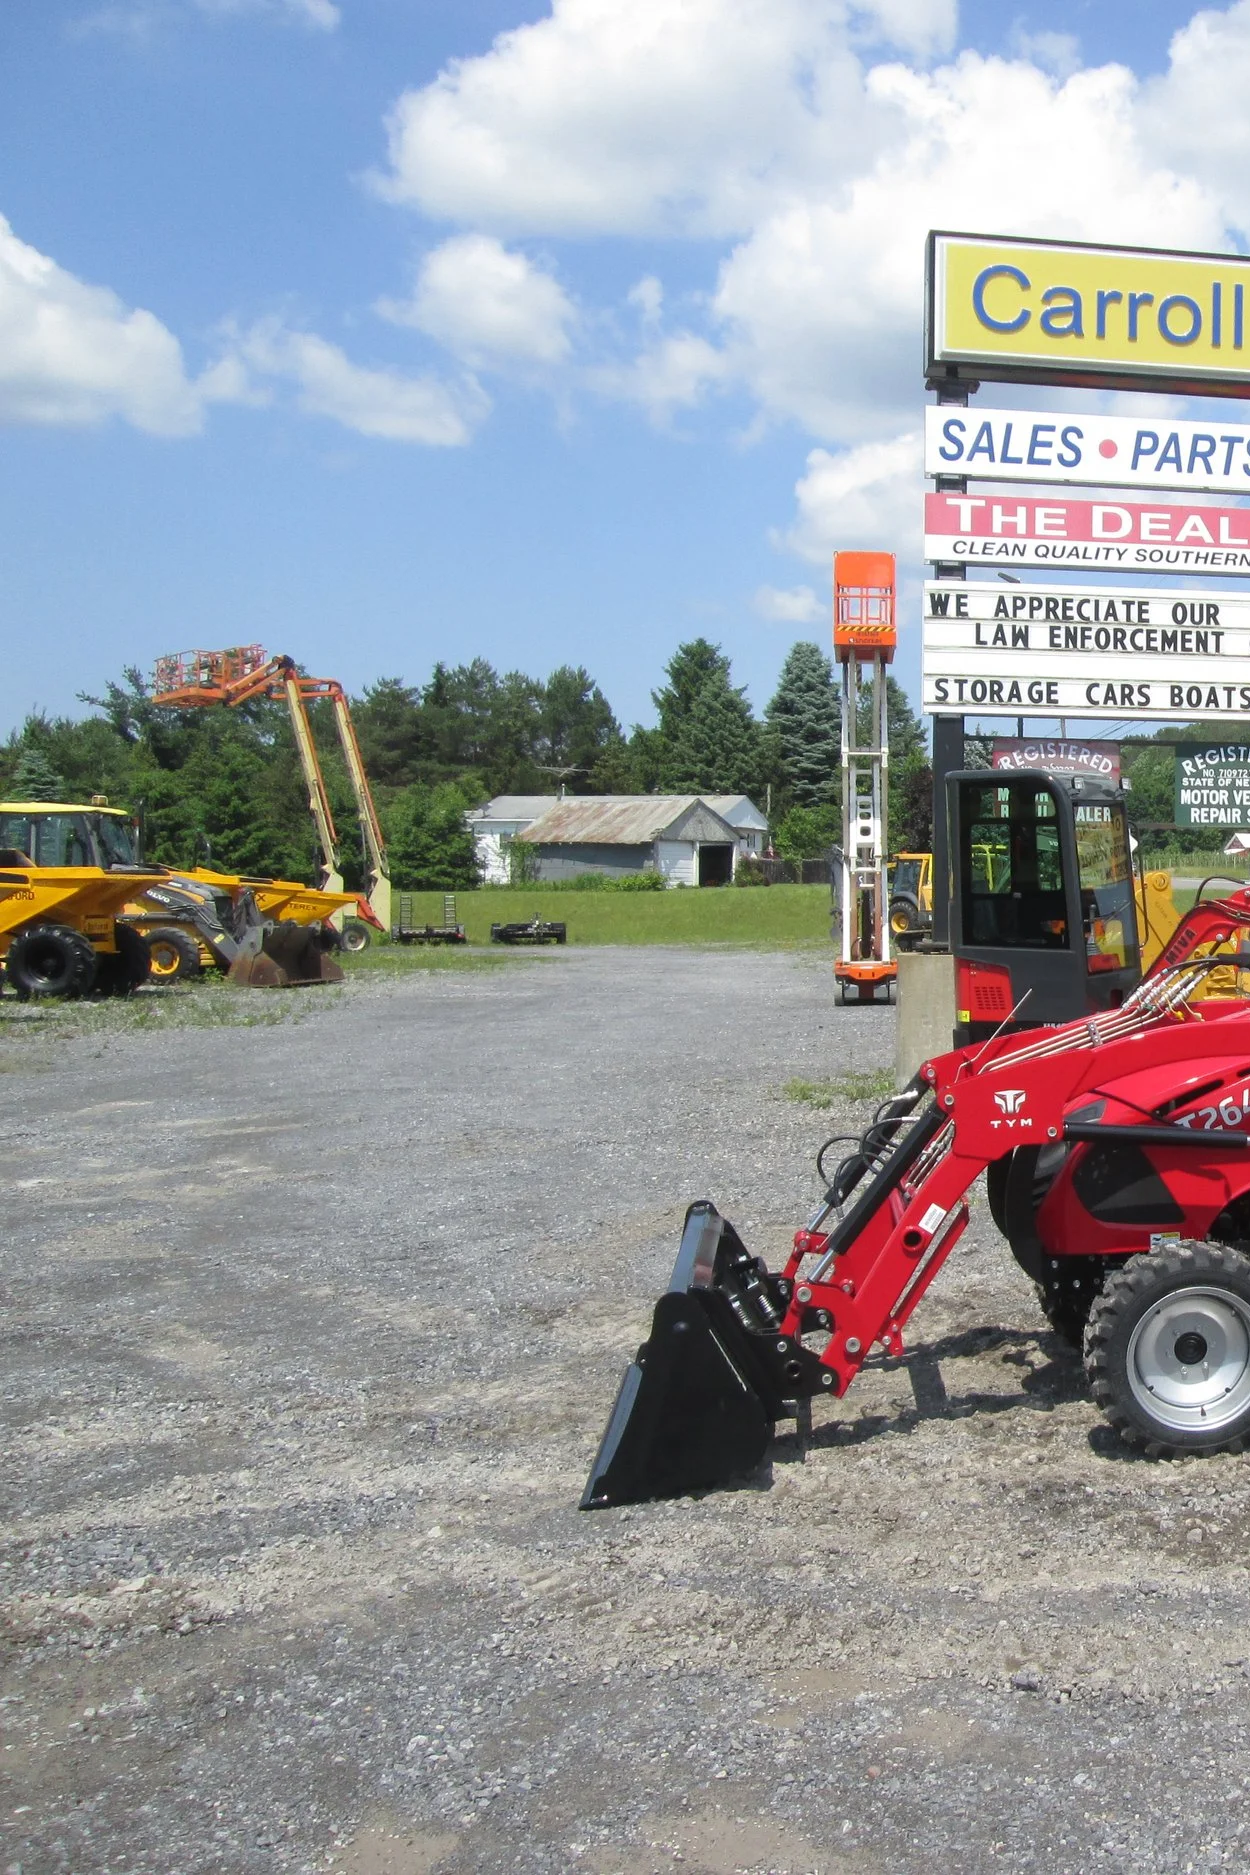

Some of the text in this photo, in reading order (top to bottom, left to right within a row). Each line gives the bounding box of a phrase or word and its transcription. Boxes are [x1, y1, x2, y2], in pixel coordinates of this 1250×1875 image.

[972, 264, 1244, 350] Carroll
[938, 418, 1084, 468] SALES
[946, 498, 1069, 537] THE
[952, 540, 1027, 557] CLEAN
[1034, 544, 1129, 562] QUALITY
[929, 592, 1220, 626] WE APPRECIATE OUR
[975, 623, 1029, 648] LAW
[1049, 626, 1225, 654] ENFORCEMENT
[934, 677, 1059, 705] STORAGE
[1085, 682, 1151, 707] CARS
[997, 742, 1113, 774] REGISTERED
[1182, 778, 1214, 786] STATE
[1218, 778, 1232, 786] OF
[1202, 769, 1215, 778] NO.
[1180, 789, 1229, 805] MOTOR
[1190, 807, 1241, 823] REPAIR
[289, 903, 317, 912] TEREX
[1165, 928, 1197, 965] MIVA
[990, 1118, 1033, 1129] TYM
